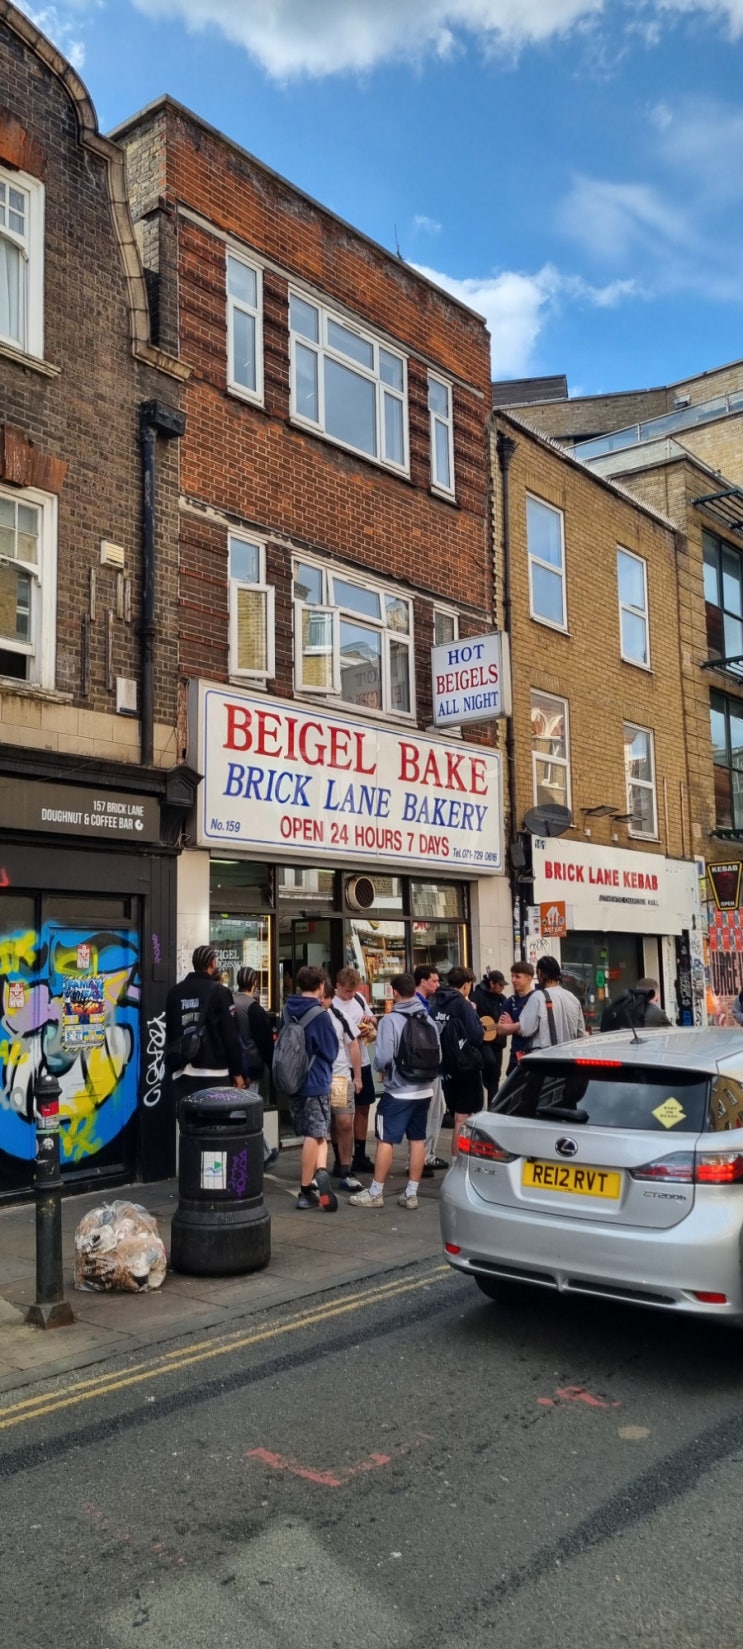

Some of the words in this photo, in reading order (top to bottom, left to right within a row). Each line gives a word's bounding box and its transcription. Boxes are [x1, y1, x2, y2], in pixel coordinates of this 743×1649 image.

[448, 644, 485, 665] HOT
[436, 664, 499, 695] BEIGELS
[438, 699, 459, 717] ALL
[463, 691, 499, 712] NIGHT
[223, 703, 377, 776] BEIGEL
[398, 741, 489, 796] BAKE
[93, 800, 105, 812] 157
[106, 802, 127, 815] BRICK
[128, 804, 144, 817] LANE
[223, 762, 313, 807] BRICK
[323, 779, 391, 818] LANE
[402, 792, 488, 832] BAKERY
[41, 808, 83, 825] DOUGHNUT
[84, 814, 90, 825] &
[91, 814, 117, 829] COFFEE
[119, 817, 134, 830] BAR
[280, 815, 324, 842] OPEN
[330, 822, 349, 845] 24
[355, 825, 401, 852] HOURS
[406, 832, 415, 852] 7
[419, 833, 450, 857] DAYS
[544, 861, 584, 883] BRICK
[588, 866, 620, 887] LANE
[623, 871, 659, 891] KEBAB
[711, 864, 738, 873] KEBAB
[533, 1164, 570, 1188] RE12
[573, 1170, 609, 1192] RVT
